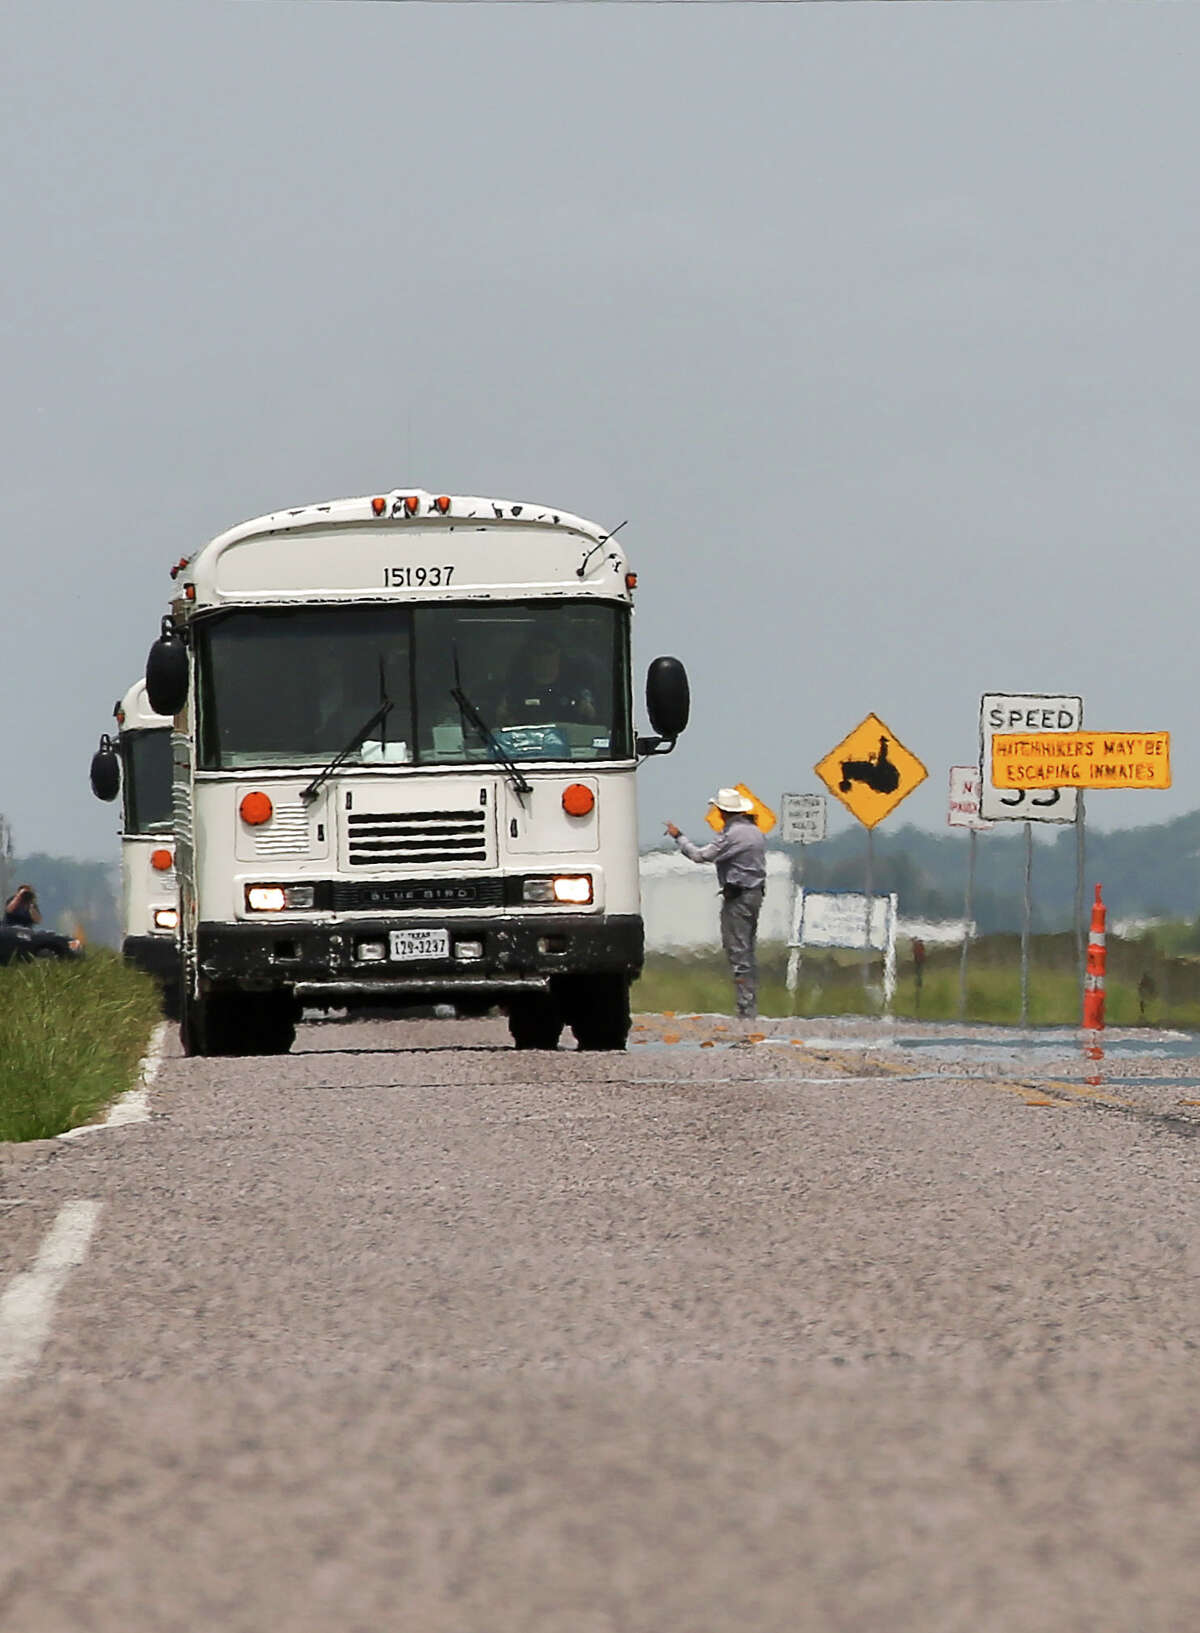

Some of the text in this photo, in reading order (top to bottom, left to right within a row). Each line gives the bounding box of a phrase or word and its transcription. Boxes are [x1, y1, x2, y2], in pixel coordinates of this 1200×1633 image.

[384, 566, 455, 587] 151937
[989, 709, 1074, 729] SPEED
[1103, 740, 1135, 755] MAY
[1145, 740, 1163, 756] BE
[1007, 763, 1155, 781] ESCAPING INMATES
